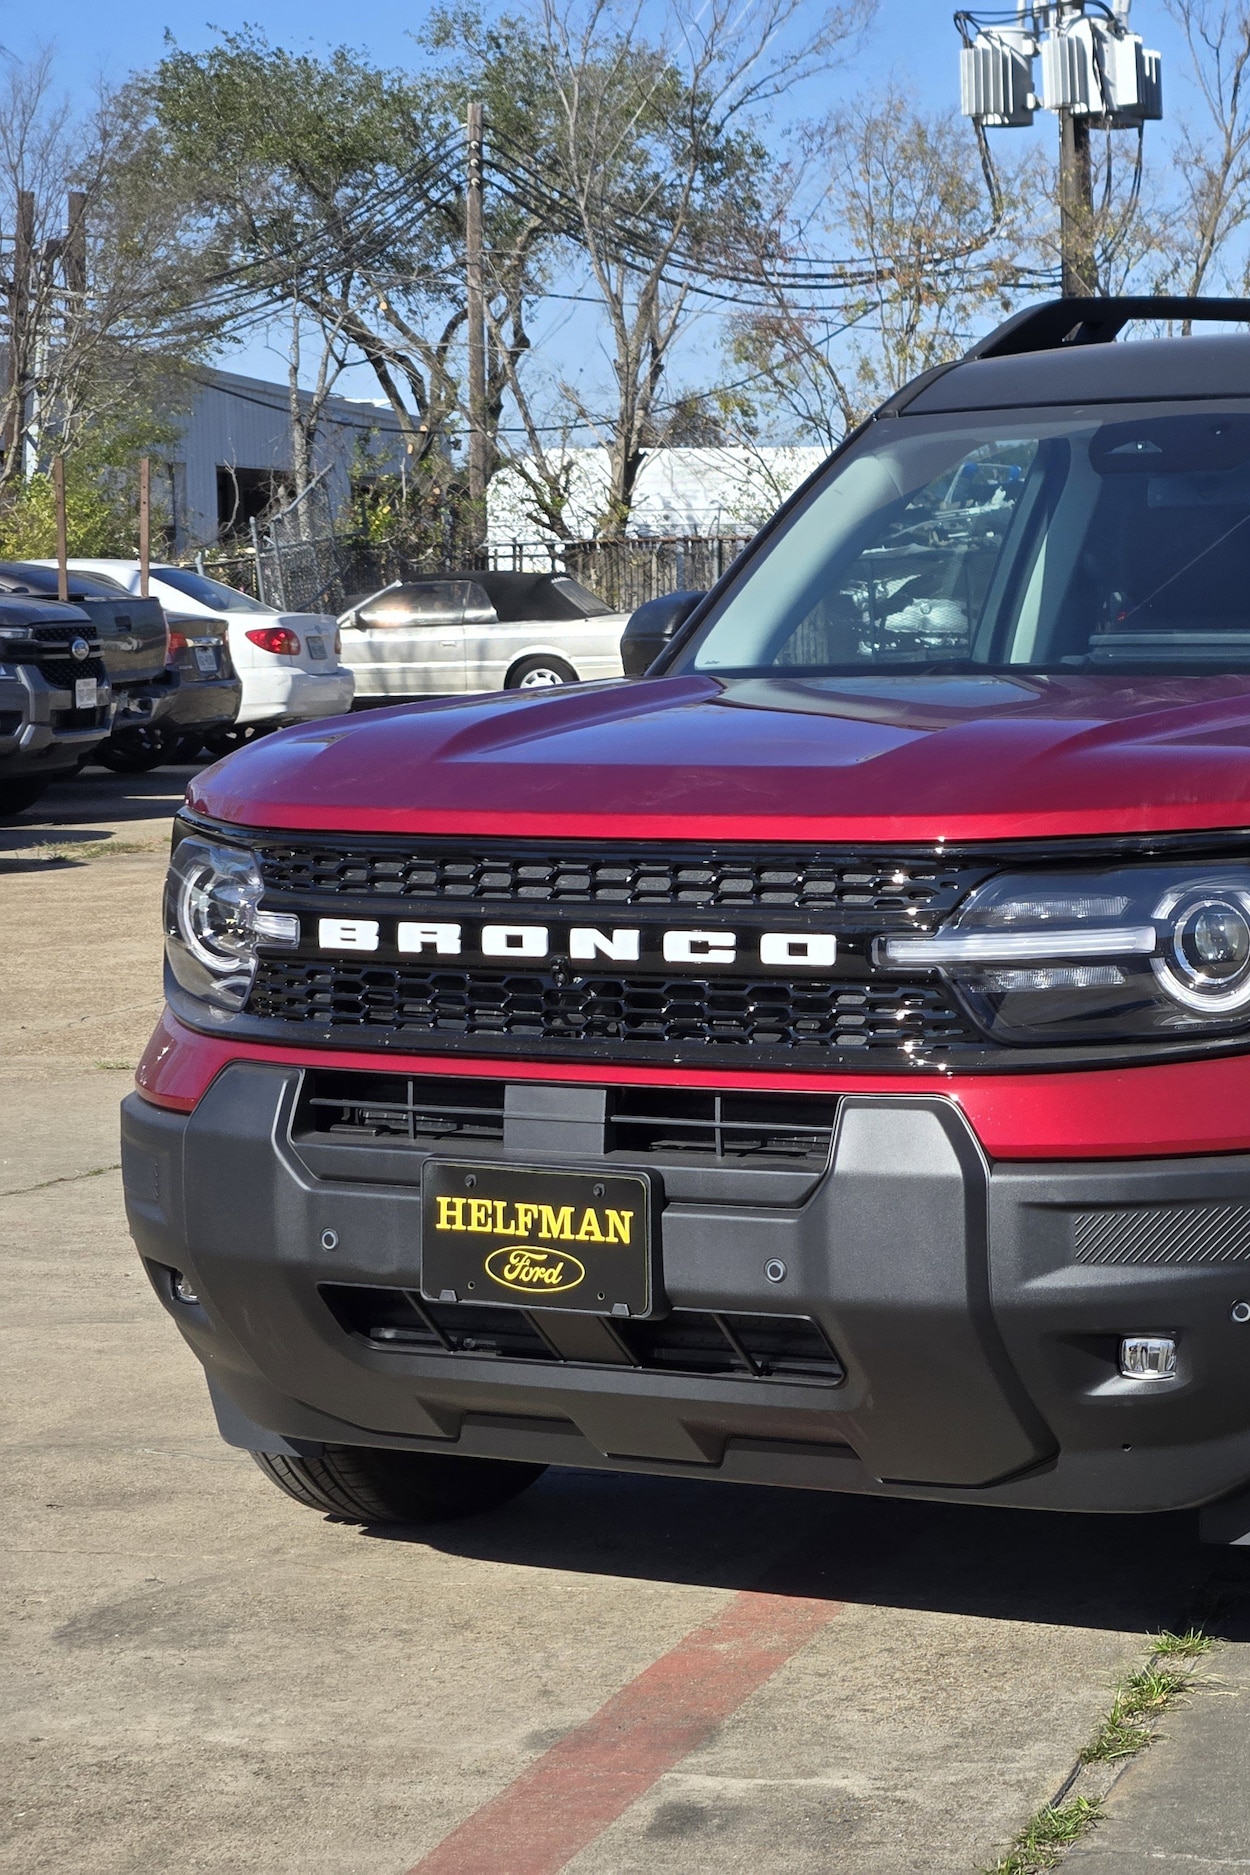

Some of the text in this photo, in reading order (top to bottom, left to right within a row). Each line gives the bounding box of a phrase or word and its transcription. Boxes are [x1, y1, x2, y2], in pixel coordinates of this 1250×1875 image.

[317, 917, 837, 966] BRONCO
[435, 1196, 635, 1245] HELFMAN
[503, 1250, 564, 1285] Ford
